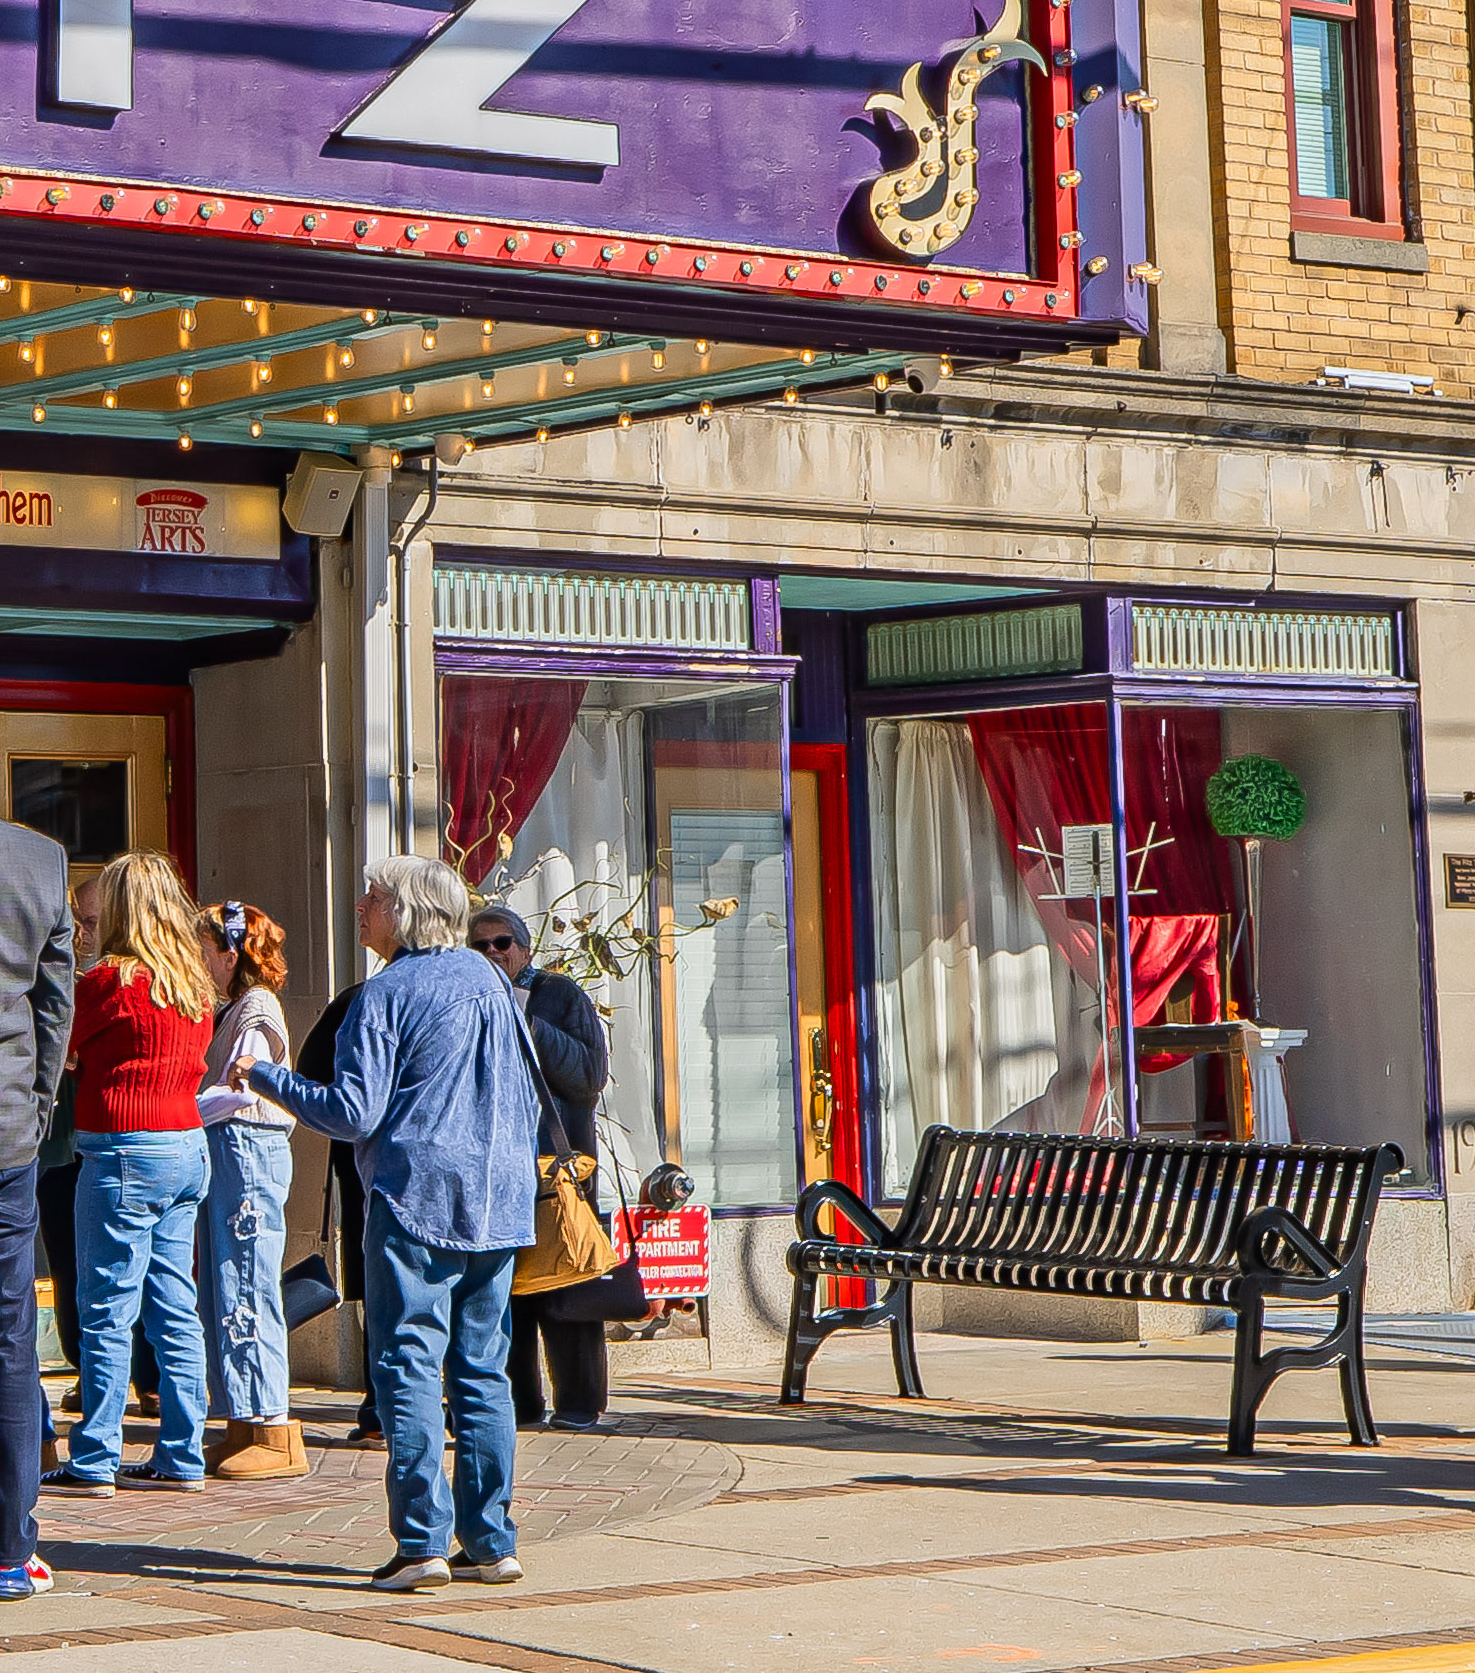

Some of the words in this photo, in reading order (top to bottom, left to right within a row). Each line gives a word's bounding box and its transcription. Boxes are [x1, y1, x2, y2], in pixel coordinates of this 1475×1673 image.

[144, 508, 205, 525] JERSEY
[139, 524, 206, 554] ARTS
[642, 1218, 681, 1239] FIRE
[623, 1240, 700, 1259] DPARTMENT
